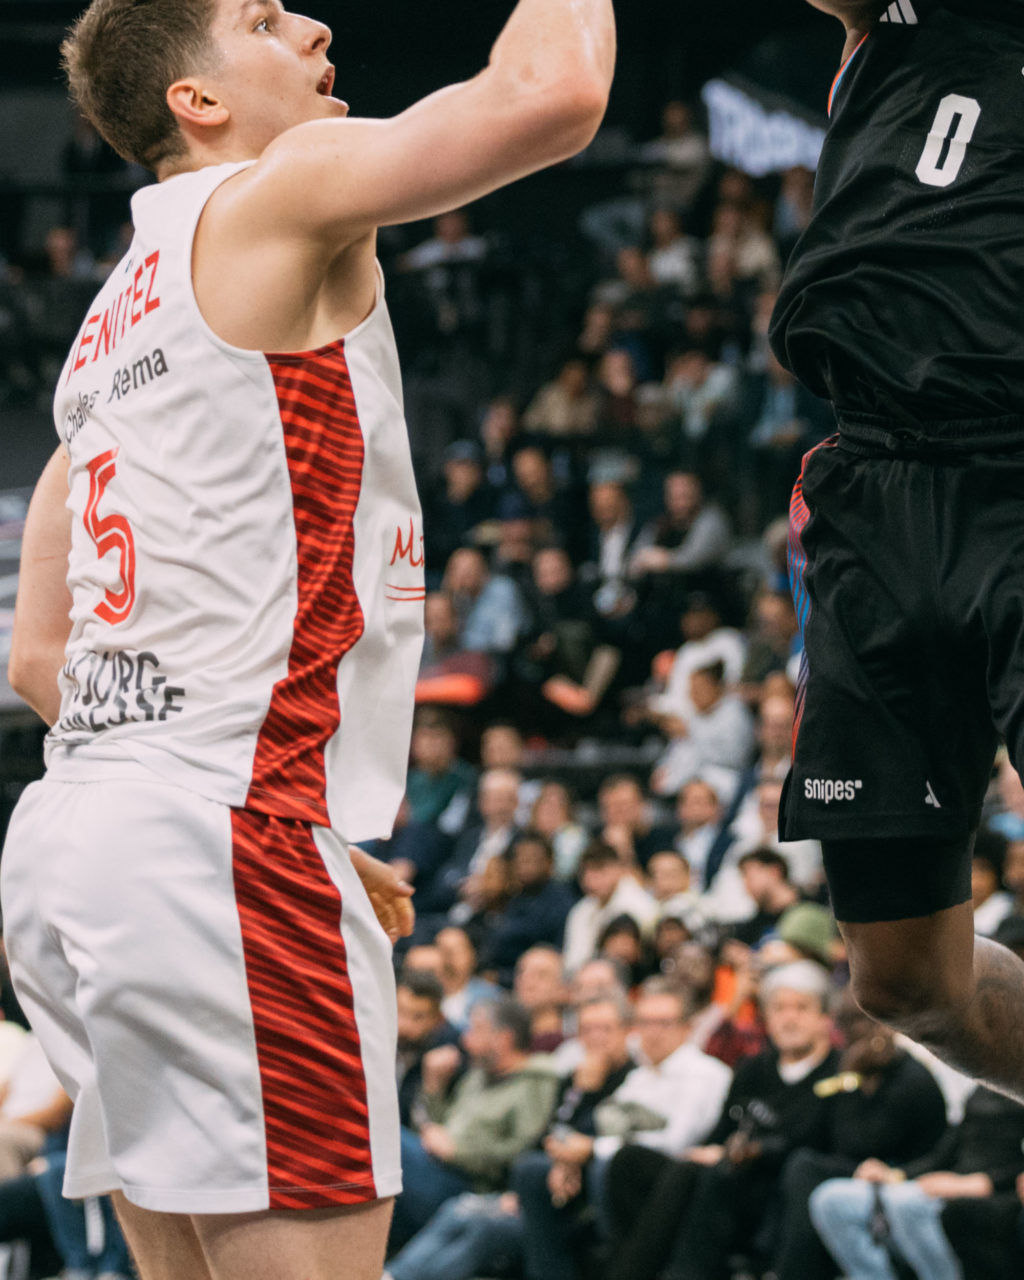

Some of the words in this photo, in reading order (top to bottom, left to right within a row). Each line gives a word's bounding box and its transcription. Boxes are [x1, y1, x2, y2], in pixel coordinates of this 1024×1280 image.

[915, 93, 981, 187] 0
[66, 250, 160, 387] ENITEZ
[83, 447, 136, 625] 5
[804, 778, 856, 804] snipes
